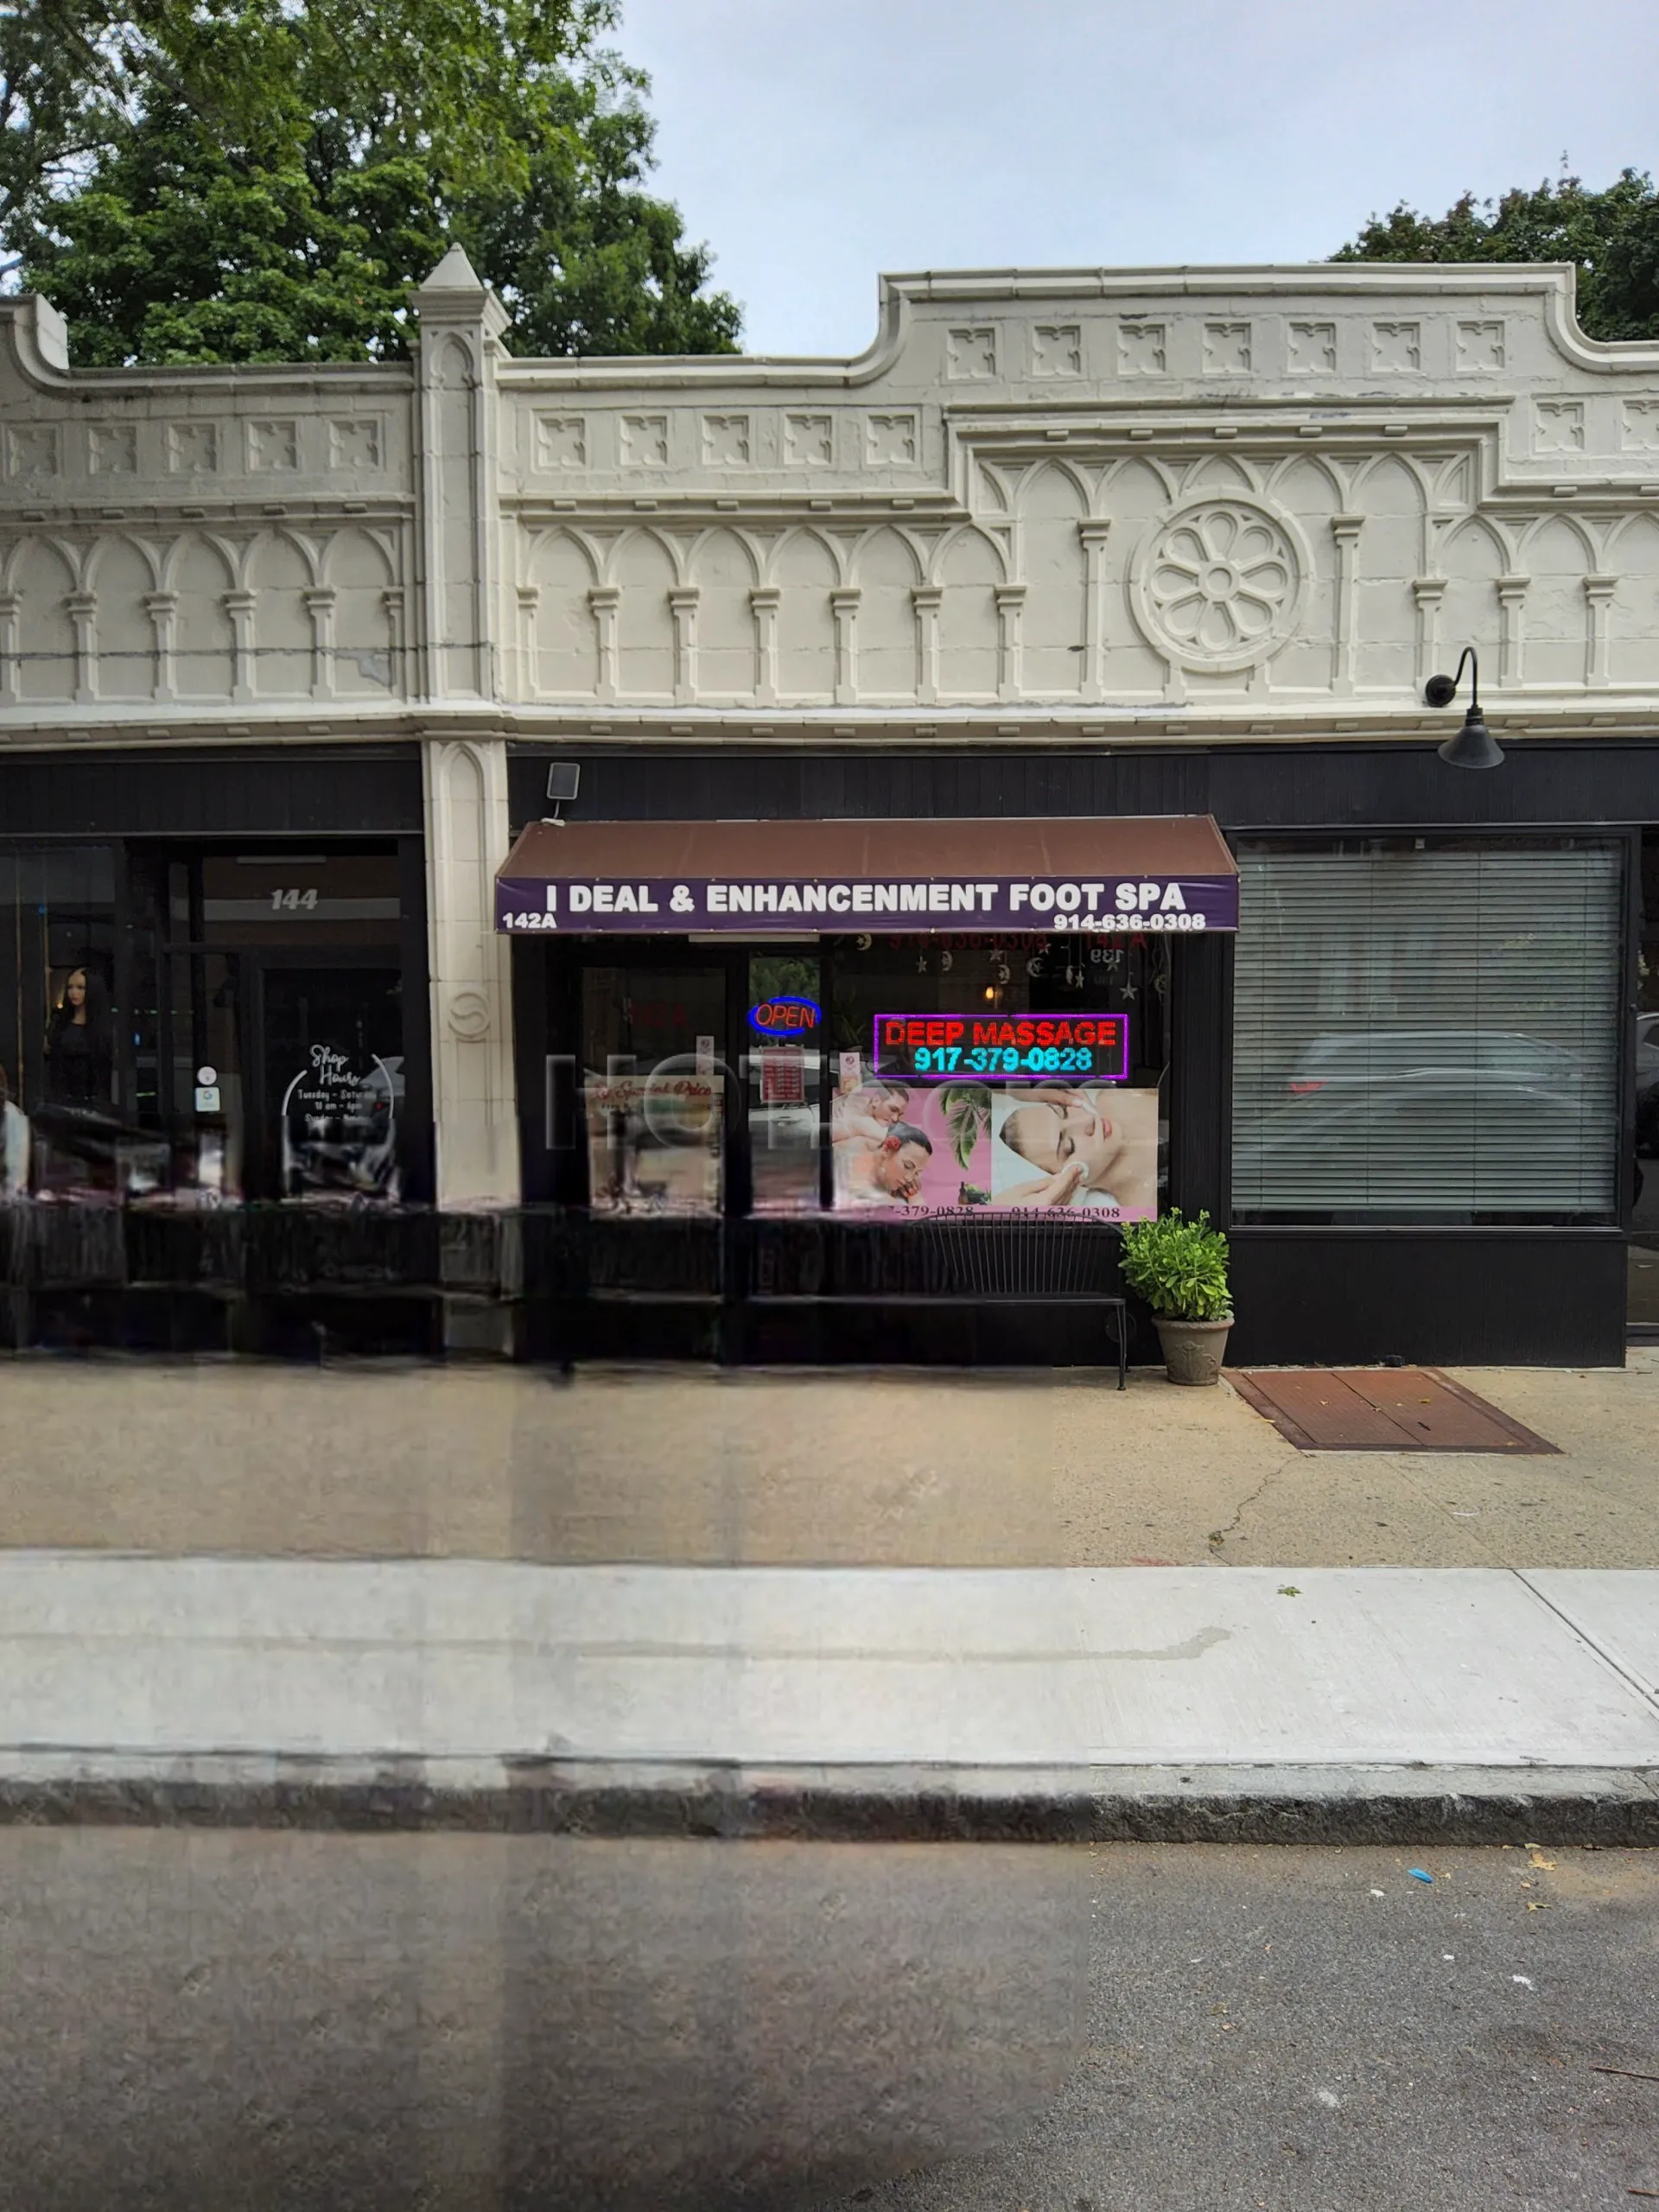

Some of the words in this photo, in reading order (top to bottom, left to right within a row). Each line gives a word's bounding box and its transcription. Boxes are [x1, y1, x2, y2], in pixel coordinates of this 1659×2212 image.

[270, 888, 318, 910] 144
[547, 885, 557, 912] I
[569, 885, 658, 912] DEAL
[670, 885, 695, 912] &
[707, 884, 998, 912] ENHANCENMENT
[1009, 883, 1104, 912] FOOT
[1115, 882, 1186, 911] SPA
[503, 912, 557, 929] 142A
[1053, 913, 1206, 931] 914-636-0308
[756, 1003, 816, 1028] OPEN
[886, 1021, 964, 1046] DEEP
[973, 1021, 1116, 1046] MASSAGE
[309, 1044, 349, 1072] Shop
[914, 1046, 1092, 1071] 917-379-0828
[319, 1064, 361, 1086] Hours
[297, 1089, 330, 1102] Tuesday
